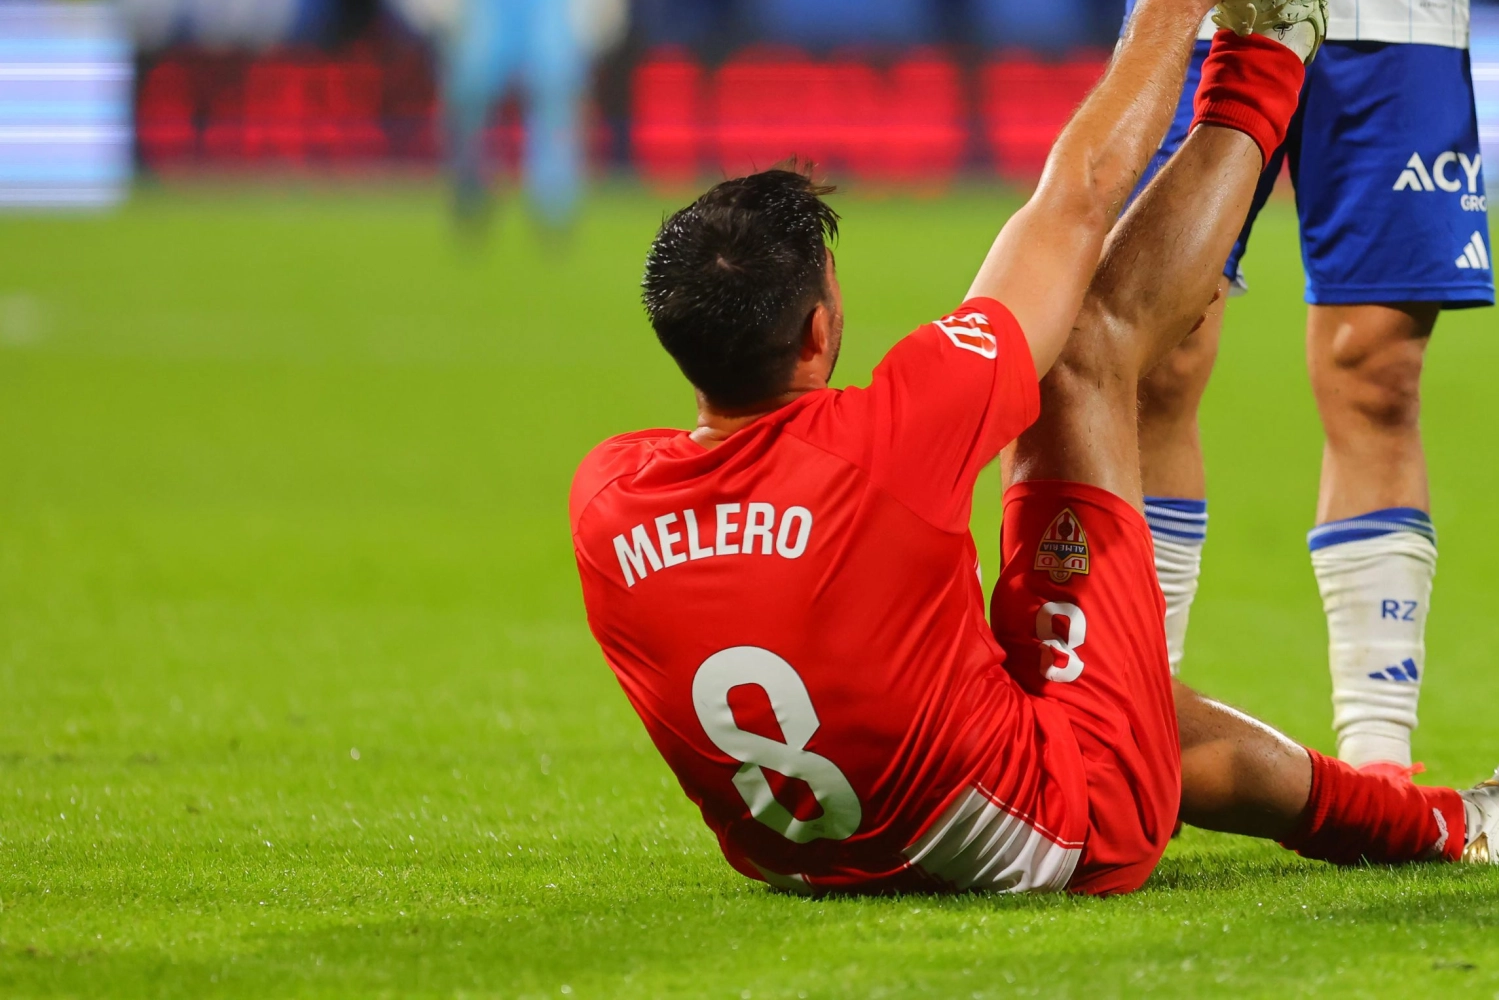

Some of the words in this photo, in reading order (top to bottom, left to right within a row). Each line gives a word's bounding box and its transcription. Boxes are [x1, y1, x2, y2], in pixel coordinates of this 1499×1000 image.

[612, 502, 813, 588] MELERO
[1042, 543, 1085, 553] ALMERIA
[1036, 601, 1087, 682] 8
[1381, 598, 1418, 621] RZ
[691, 645, 862, 844] 8
